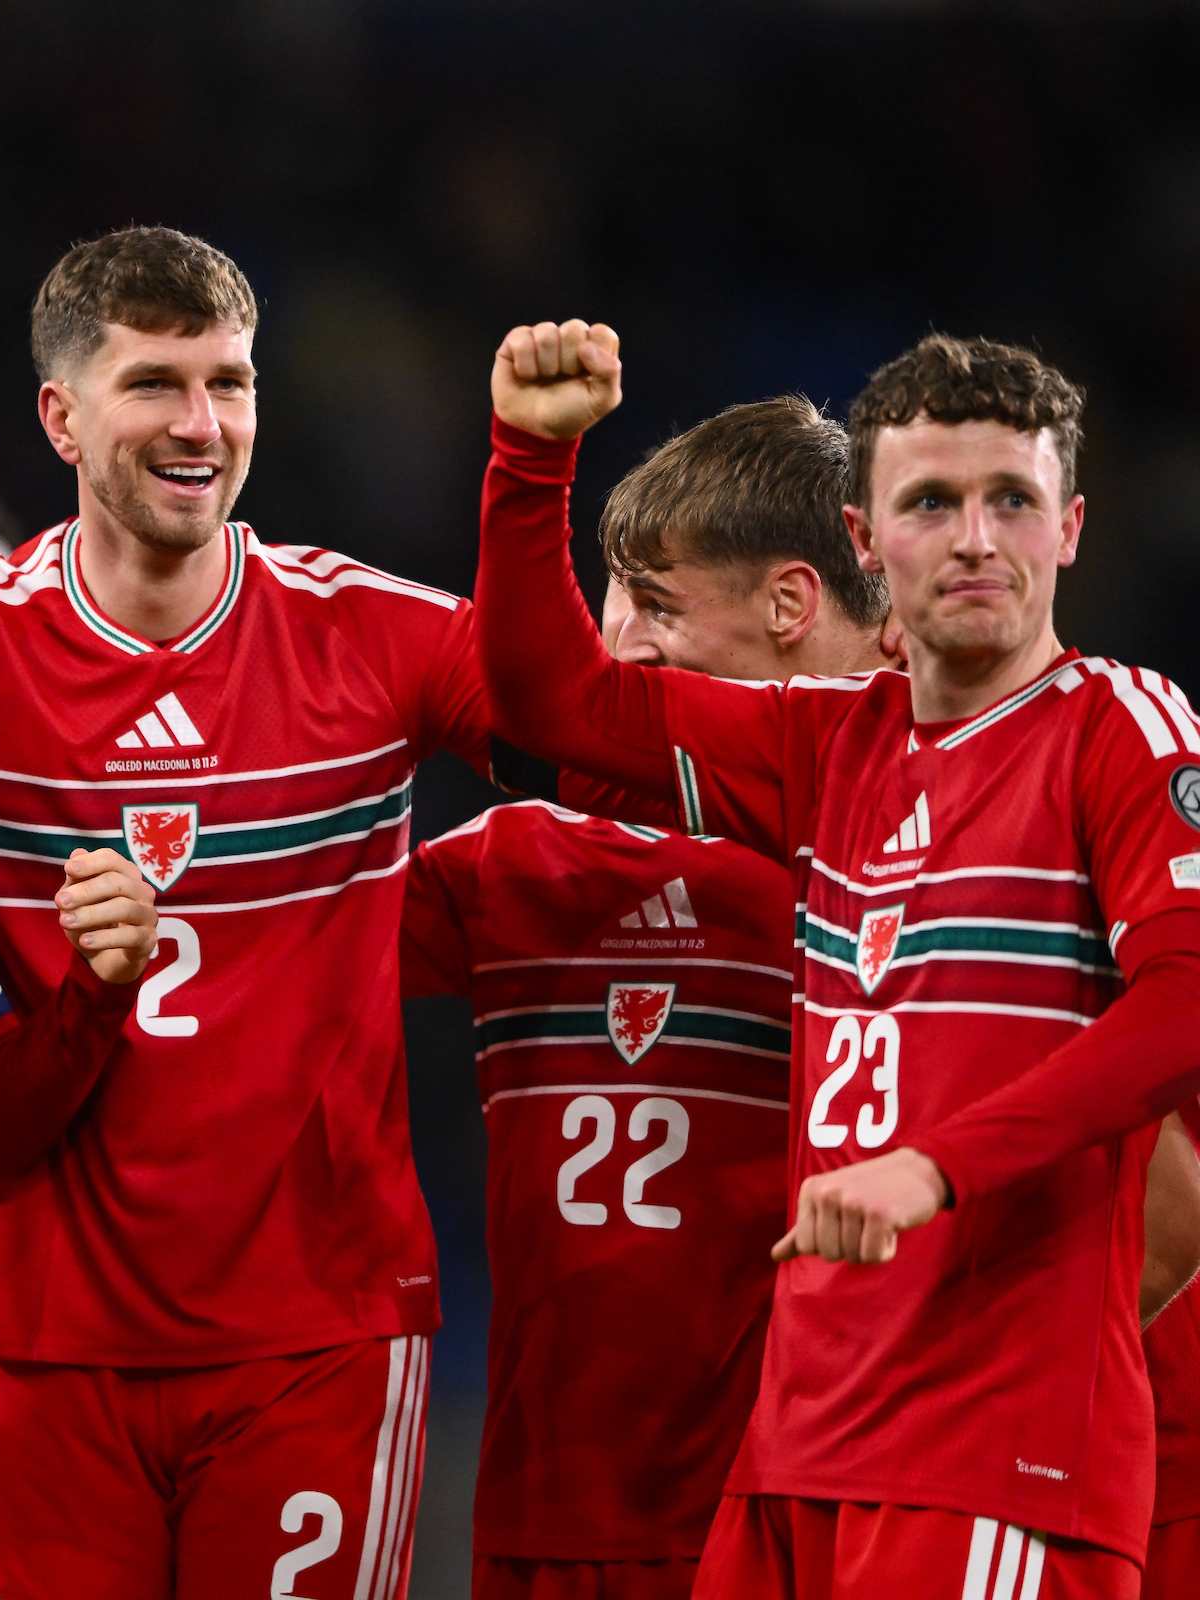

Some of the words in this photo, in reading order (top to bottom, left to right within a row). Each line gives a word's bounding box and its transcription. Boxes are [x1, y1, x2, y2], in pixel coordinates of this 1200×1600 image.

[105, 760, 142, 772] GOGLEDD
[143, 759, 191, 771] MACEDONIA
[191, 758, 201, 770] 18
[201, 757, 209, 768] 11
[209, 755, 218, 768] 25
[136, 917, 201, 1037] 2
[600, 938, 634, 949] GOGLEDD
[635, 939, 677, 949] MACEDONIA
[808, 1013, 901, 1149] 23
[557, 1095, 690, 1229] 22
[270, 1491, 343, 1600] 2
